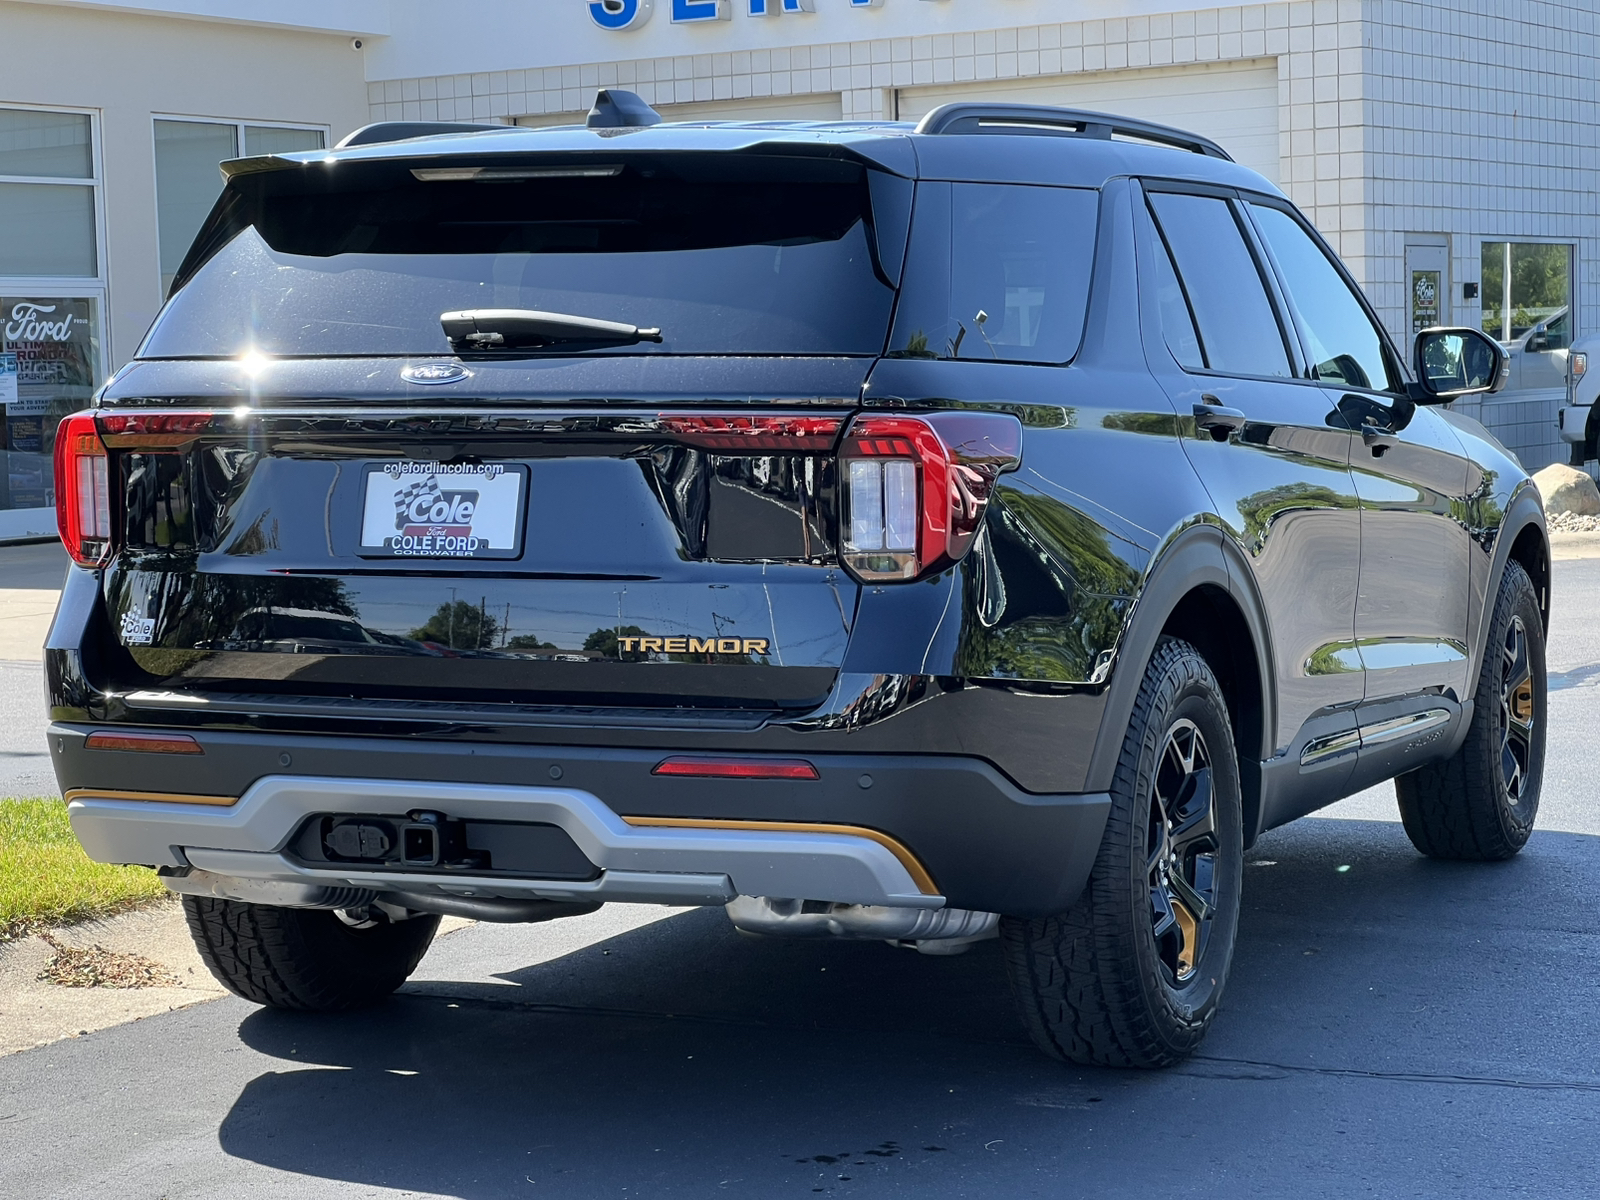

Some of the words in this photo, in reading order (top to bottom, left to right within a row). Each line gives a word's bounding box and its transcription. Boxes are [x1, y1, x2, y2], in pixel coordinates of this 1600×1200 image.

[5, 302, 73, 341] Ford
[383, 461, 505, 475] colefordlincoln.com
[408, 494, 475, 523] Cole
[426, 525, 447, 536] Ford
[391, 536, 432, 550] COLE
[436, 537, 479, 551] FORD
[125, 621, 150, 634] Cole
[617, 636, 769, 654] TREMOR
